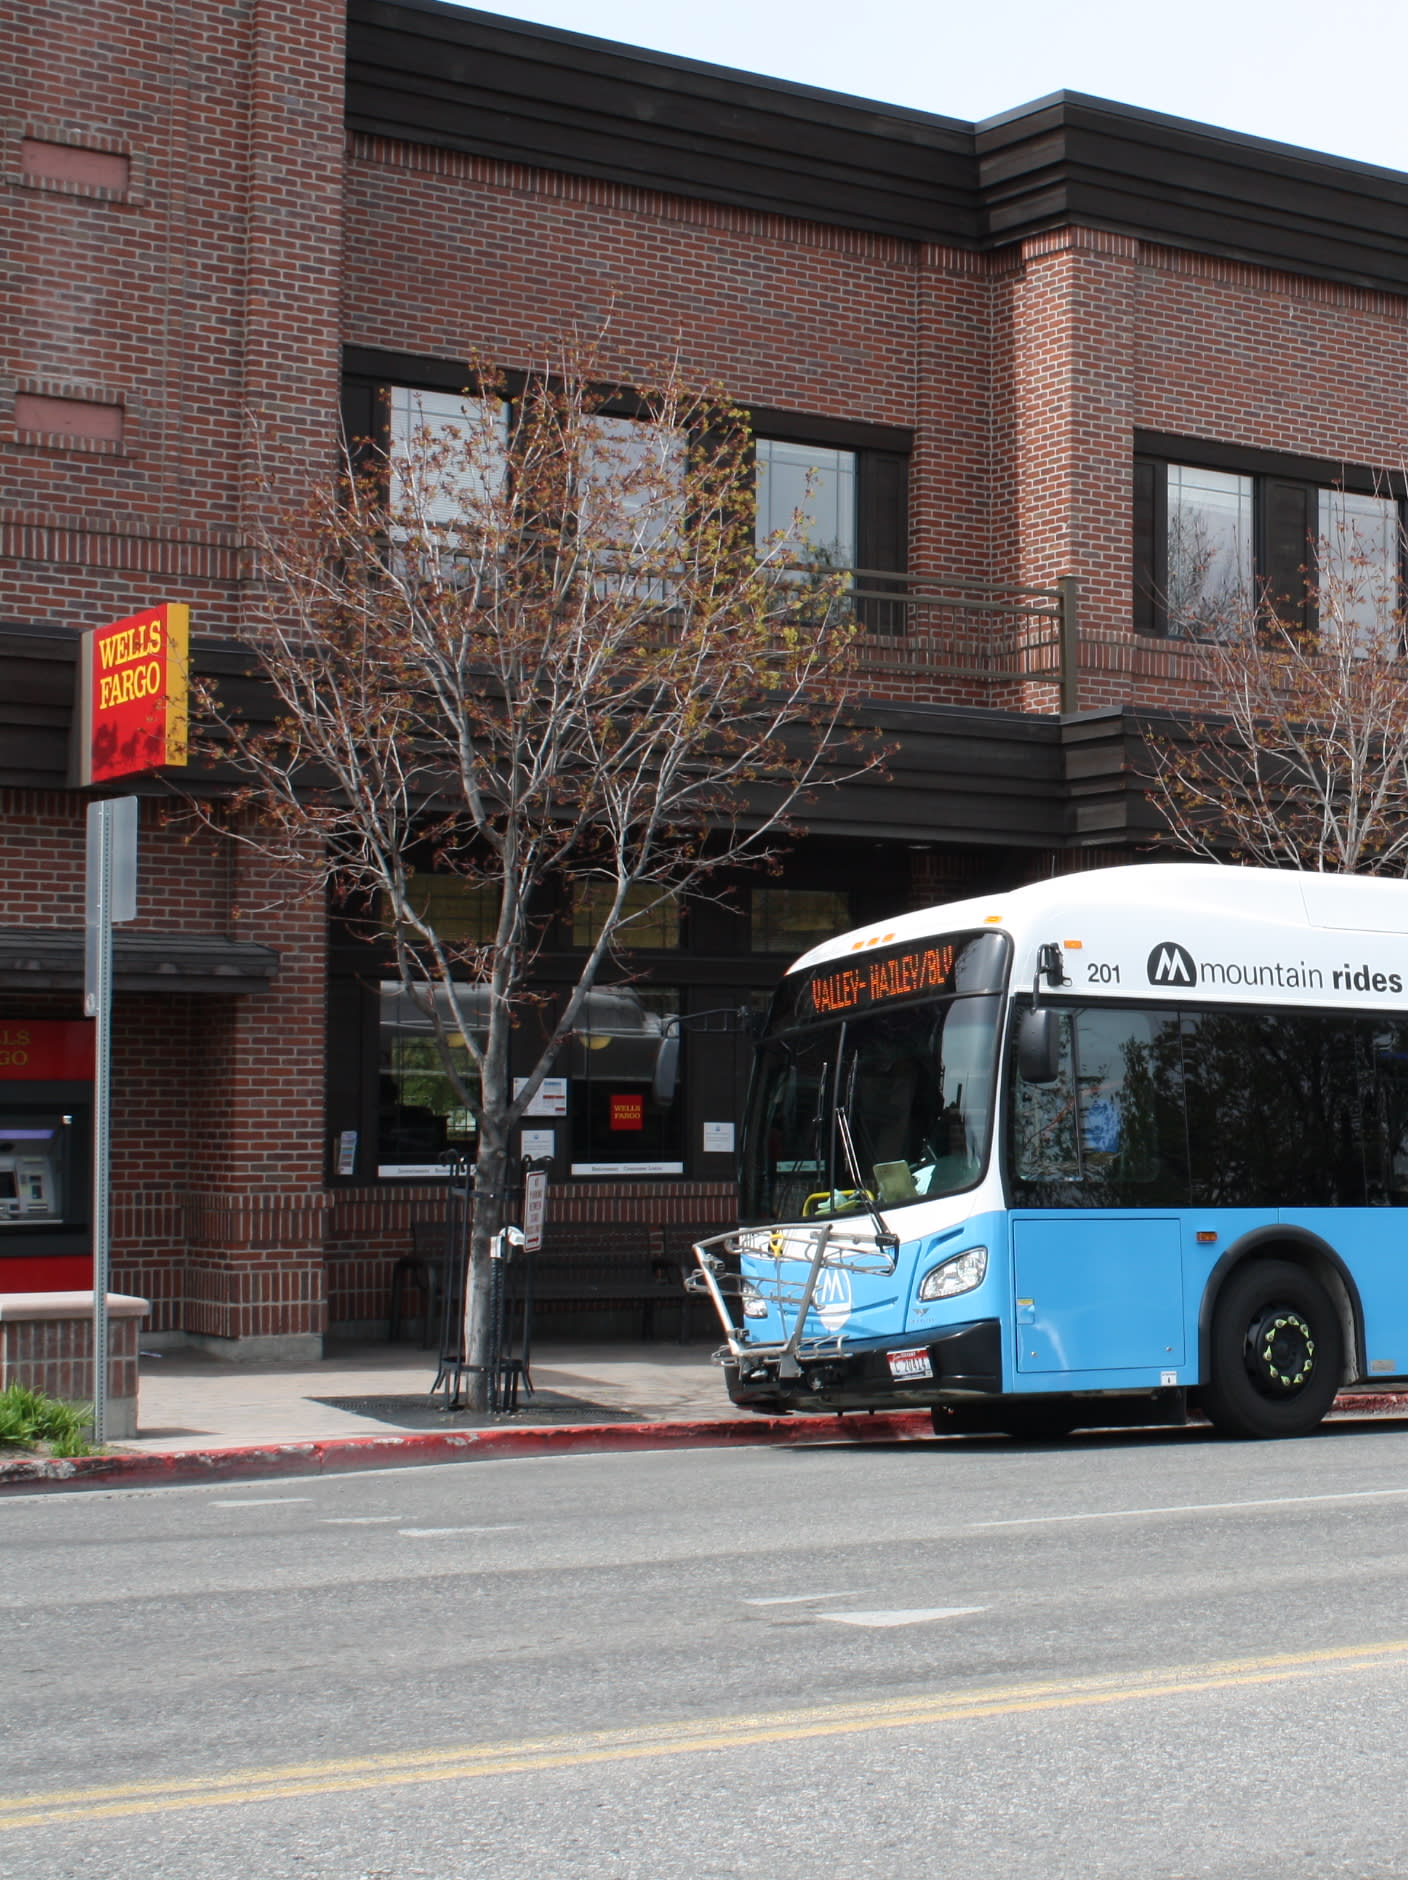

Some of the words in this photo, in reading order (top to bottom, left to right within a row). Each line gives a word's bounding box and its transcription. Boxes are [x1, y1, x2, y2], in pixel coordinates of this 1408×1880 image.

[98, 620, 161, 670] WELLS
[99, 661, 160, 710] FARGO
[1087, 963, 1121, 984] 201
[1200, 960, 1324, 989] mountain
[1332, 964, 1403, 993] rides
